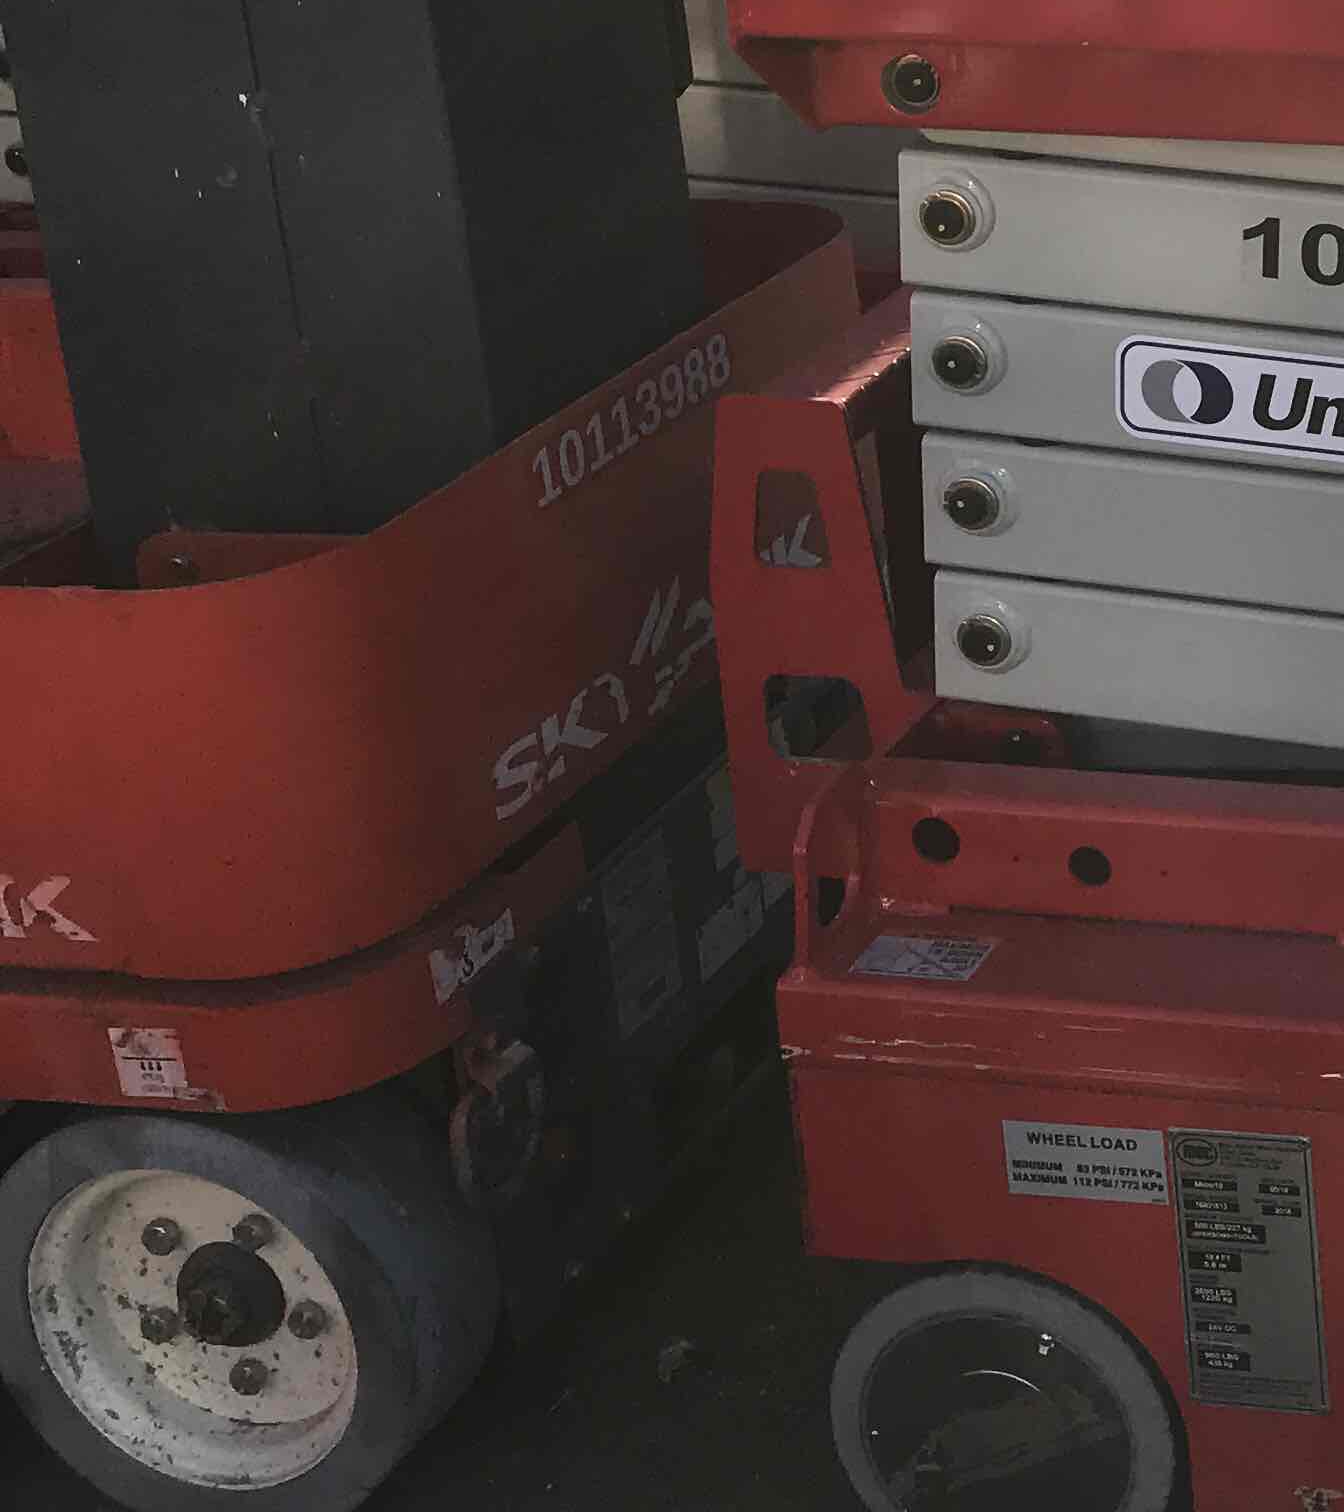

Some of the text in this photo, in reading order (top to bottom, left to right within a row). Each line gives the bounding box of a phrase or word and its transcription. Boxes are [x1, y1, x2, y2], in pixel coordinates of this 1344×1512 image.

[531, 333, 732, 508] 10113988
[1026, 1131, 1138, 1151] WHEEL LOAD
[1092, 1164, 1110, 1175] PSI
[1012, 1172, 1068, 1185] MAXIMUM
[1094, 1177, 1113, 1188] PSI
